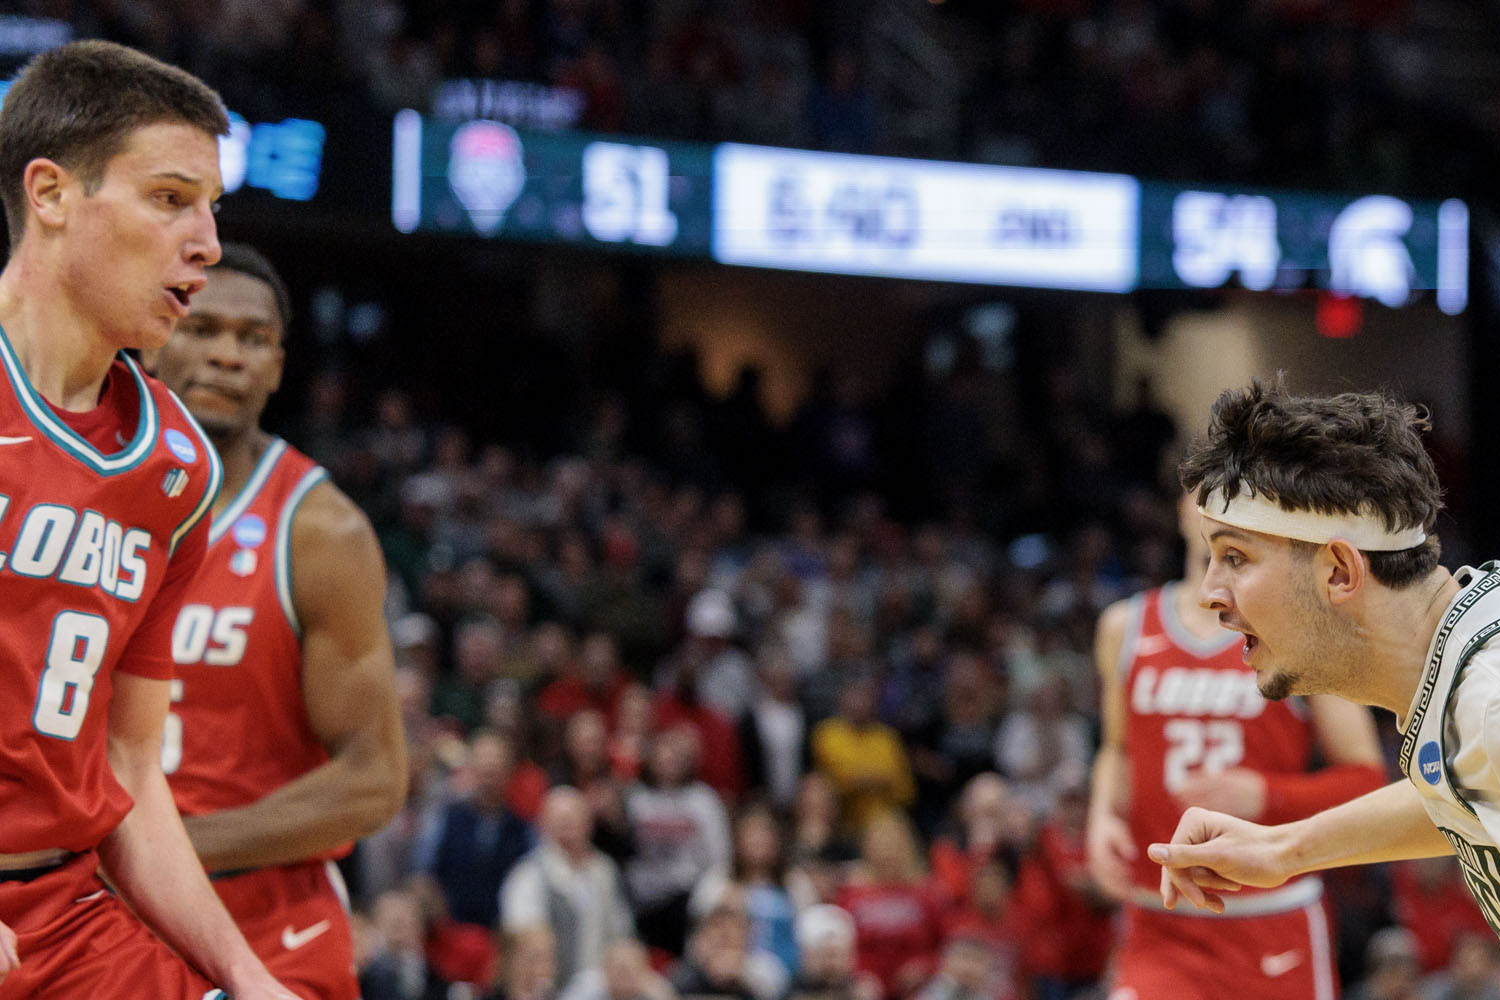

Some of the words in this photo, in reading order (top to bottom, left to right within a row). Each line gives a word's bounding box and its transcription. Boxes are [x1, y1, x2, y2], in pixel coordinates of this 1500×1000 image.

[582, 141, 677, 246] 51
[1172, 190, 1281, 291] 54
[33, 610, 109, 741] 8
[1164, 719, 1245, 793] 22
